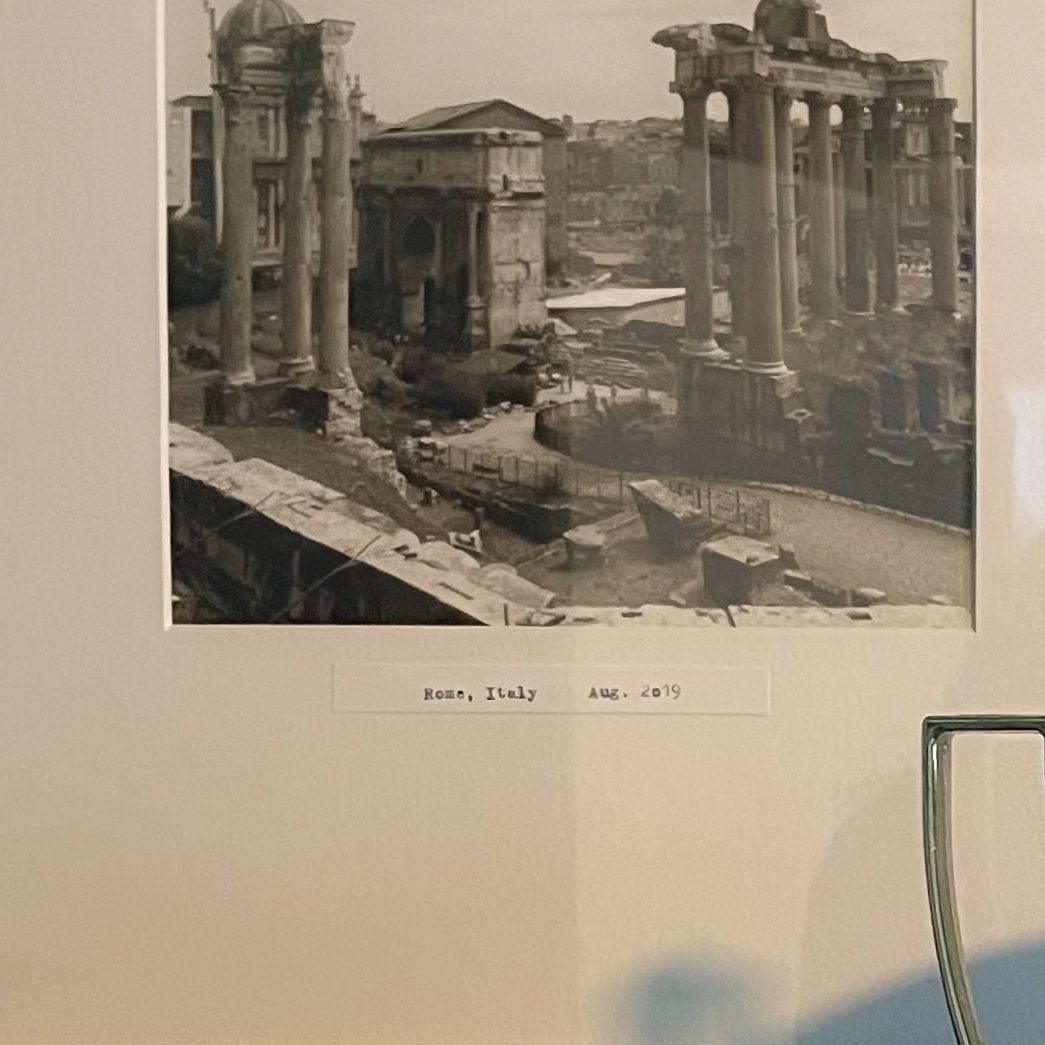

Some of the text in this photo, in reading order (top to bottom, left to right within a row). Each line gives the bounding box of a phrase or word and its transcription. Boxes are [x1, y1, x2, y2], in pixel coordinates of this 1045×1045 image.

[423, 687, 473, 702] Rome,
[486, 686, 537, 702] Italy
[588, 687, 629, 700] Aug.
